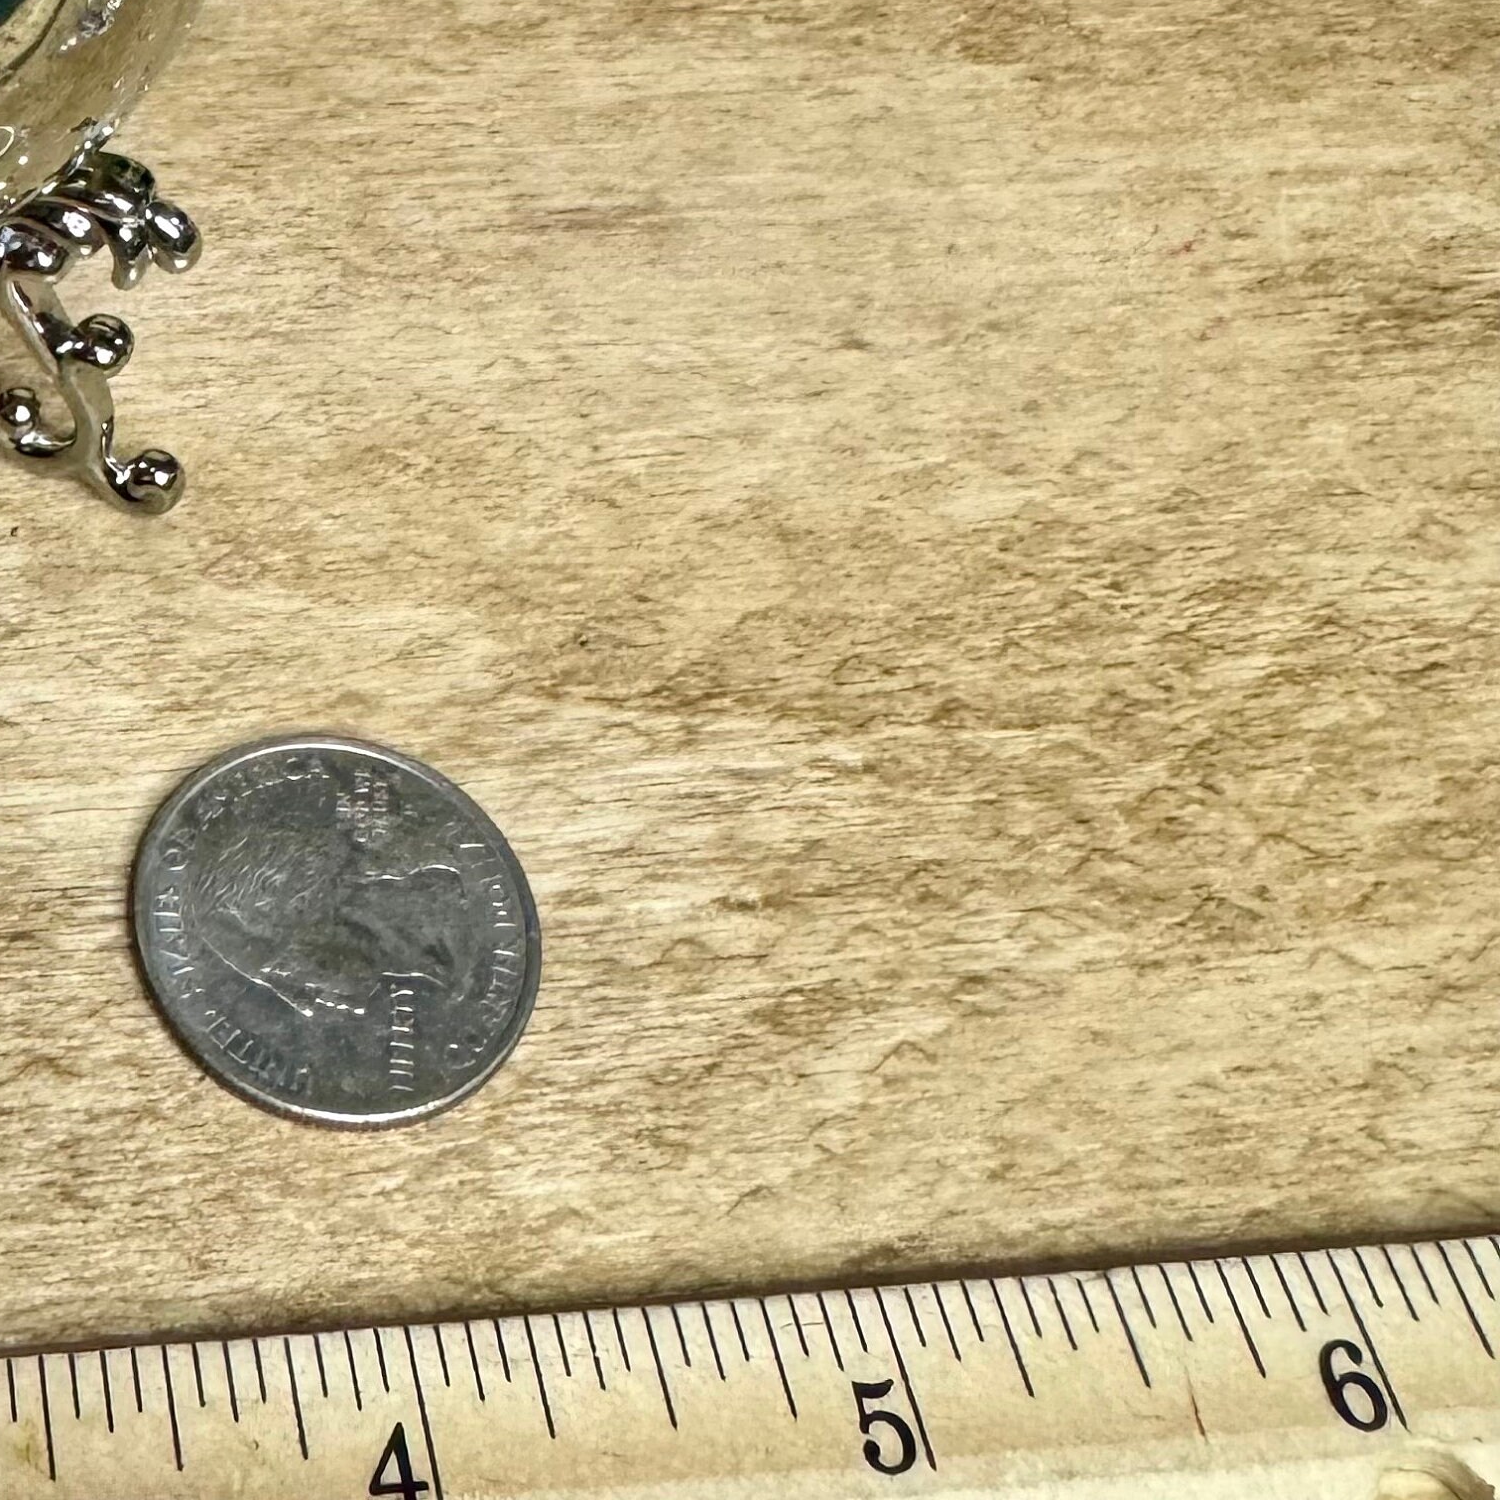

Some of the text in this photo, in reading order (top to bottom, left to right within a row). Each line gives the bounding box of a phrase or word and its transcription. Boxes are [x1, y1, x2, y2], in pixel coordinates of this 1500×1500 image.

[368, 1337, 1389, 1500] 4 5 6
